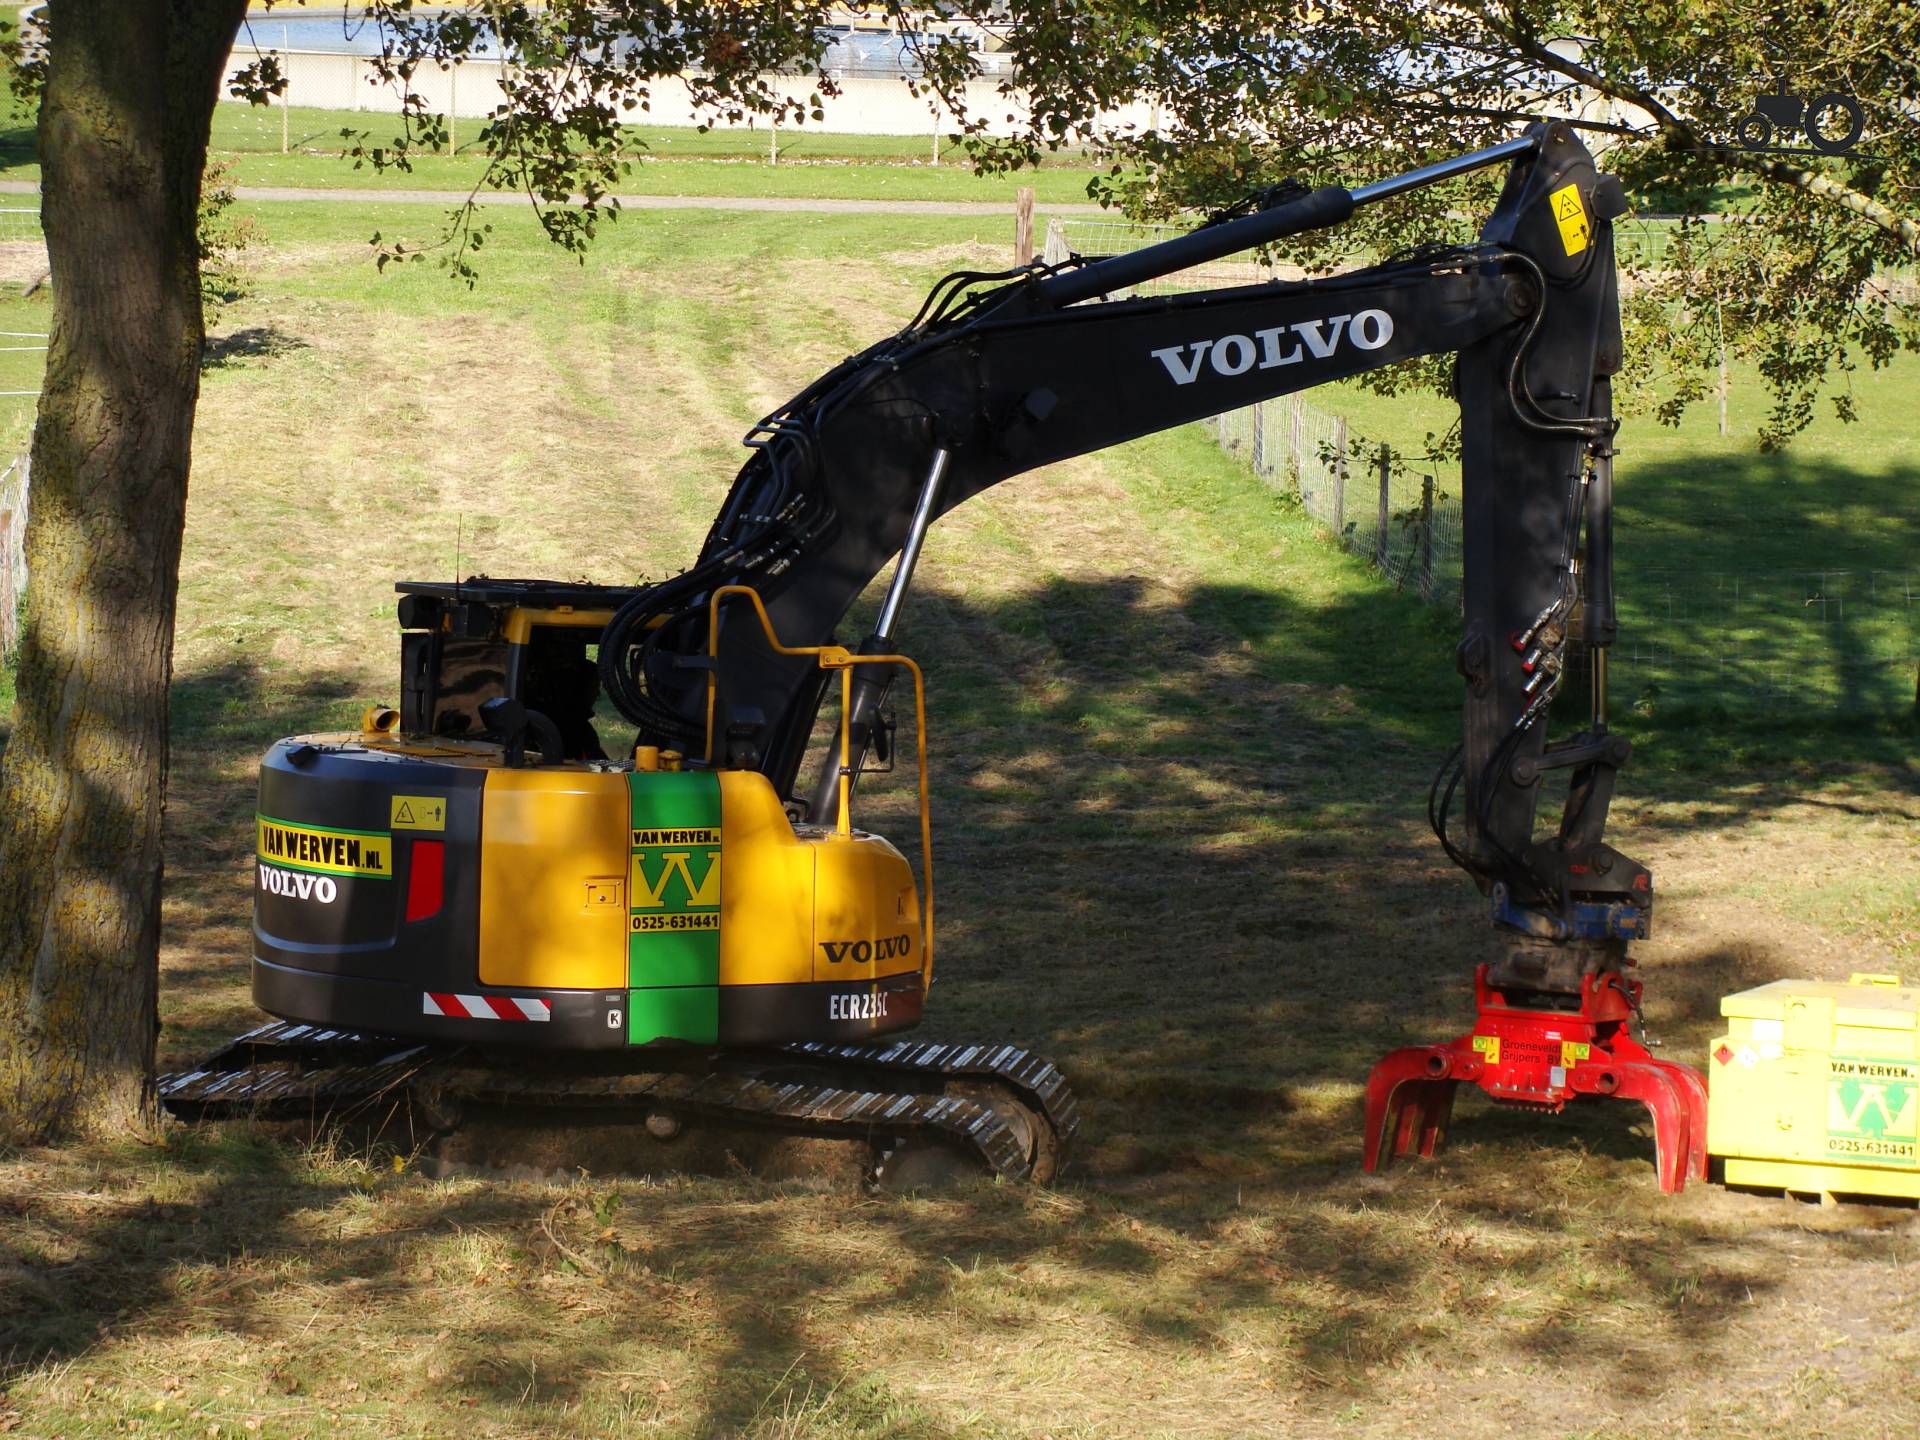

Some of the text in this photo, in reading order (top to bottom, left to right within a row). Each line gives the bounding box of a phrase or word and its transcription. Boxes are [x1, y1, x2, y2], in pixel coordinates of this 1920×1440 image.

[1151, 309, 1394, 385] VOLVO
[263, 825, 283, 857] VAN
[633, 831, 659, 845] VAN
[259, 864, 337, 904] VOLVO
[632, 915, 719, 930] 0525-631441
[818, 934, 911, 964] VOLVO
[830, 991, 888, 1020] ECR235C
[1501, 1050, 1541, 1064] Grijpers
[1831, 1062, 1855, 1073] VAN
[1829, 1139, 1914, 1156] 0525-631441
